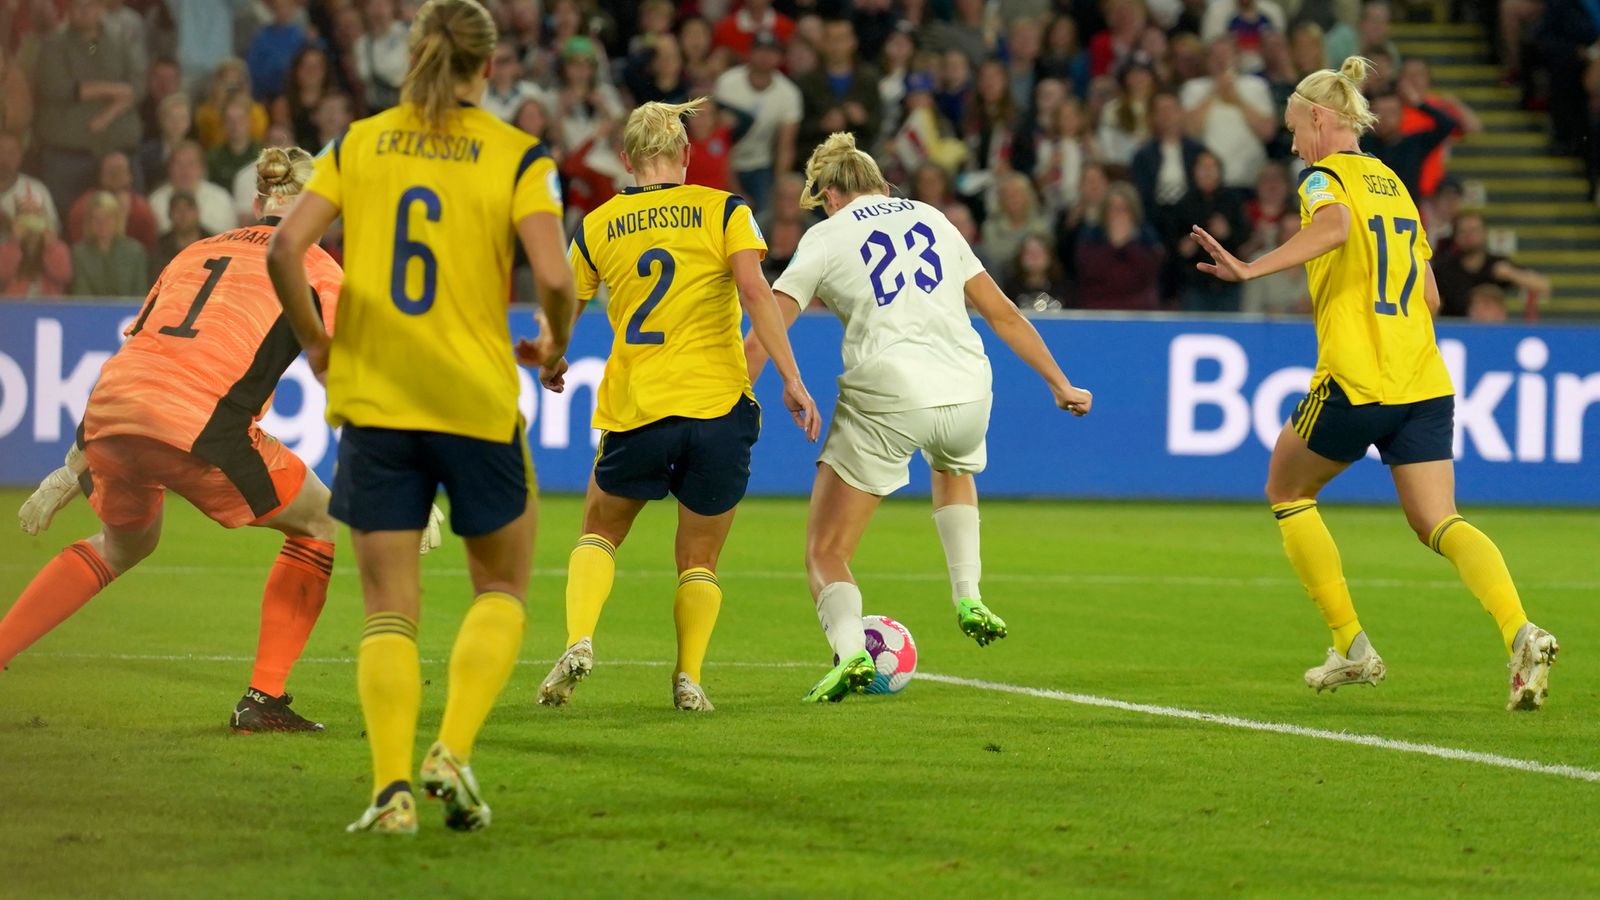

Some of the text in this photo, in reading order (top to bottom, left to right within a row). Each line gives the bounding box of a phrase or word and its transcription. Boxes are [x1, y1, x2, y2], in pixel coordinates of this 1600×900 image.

[376, 129, 484, 163] ERIKSSON
[1362, 174, 1401, 197] SEGER
[390, 186, 442, 316] 6
[607, 205, 702, 242] ANDERSSON
[852, 199, 916, 221] RUSSO
[158, 256, 232, 338] 1
[625, 248, 675, 344] 2
[859, 221, 943, 307] 23
[1368, 214, 1418, 317] 17
